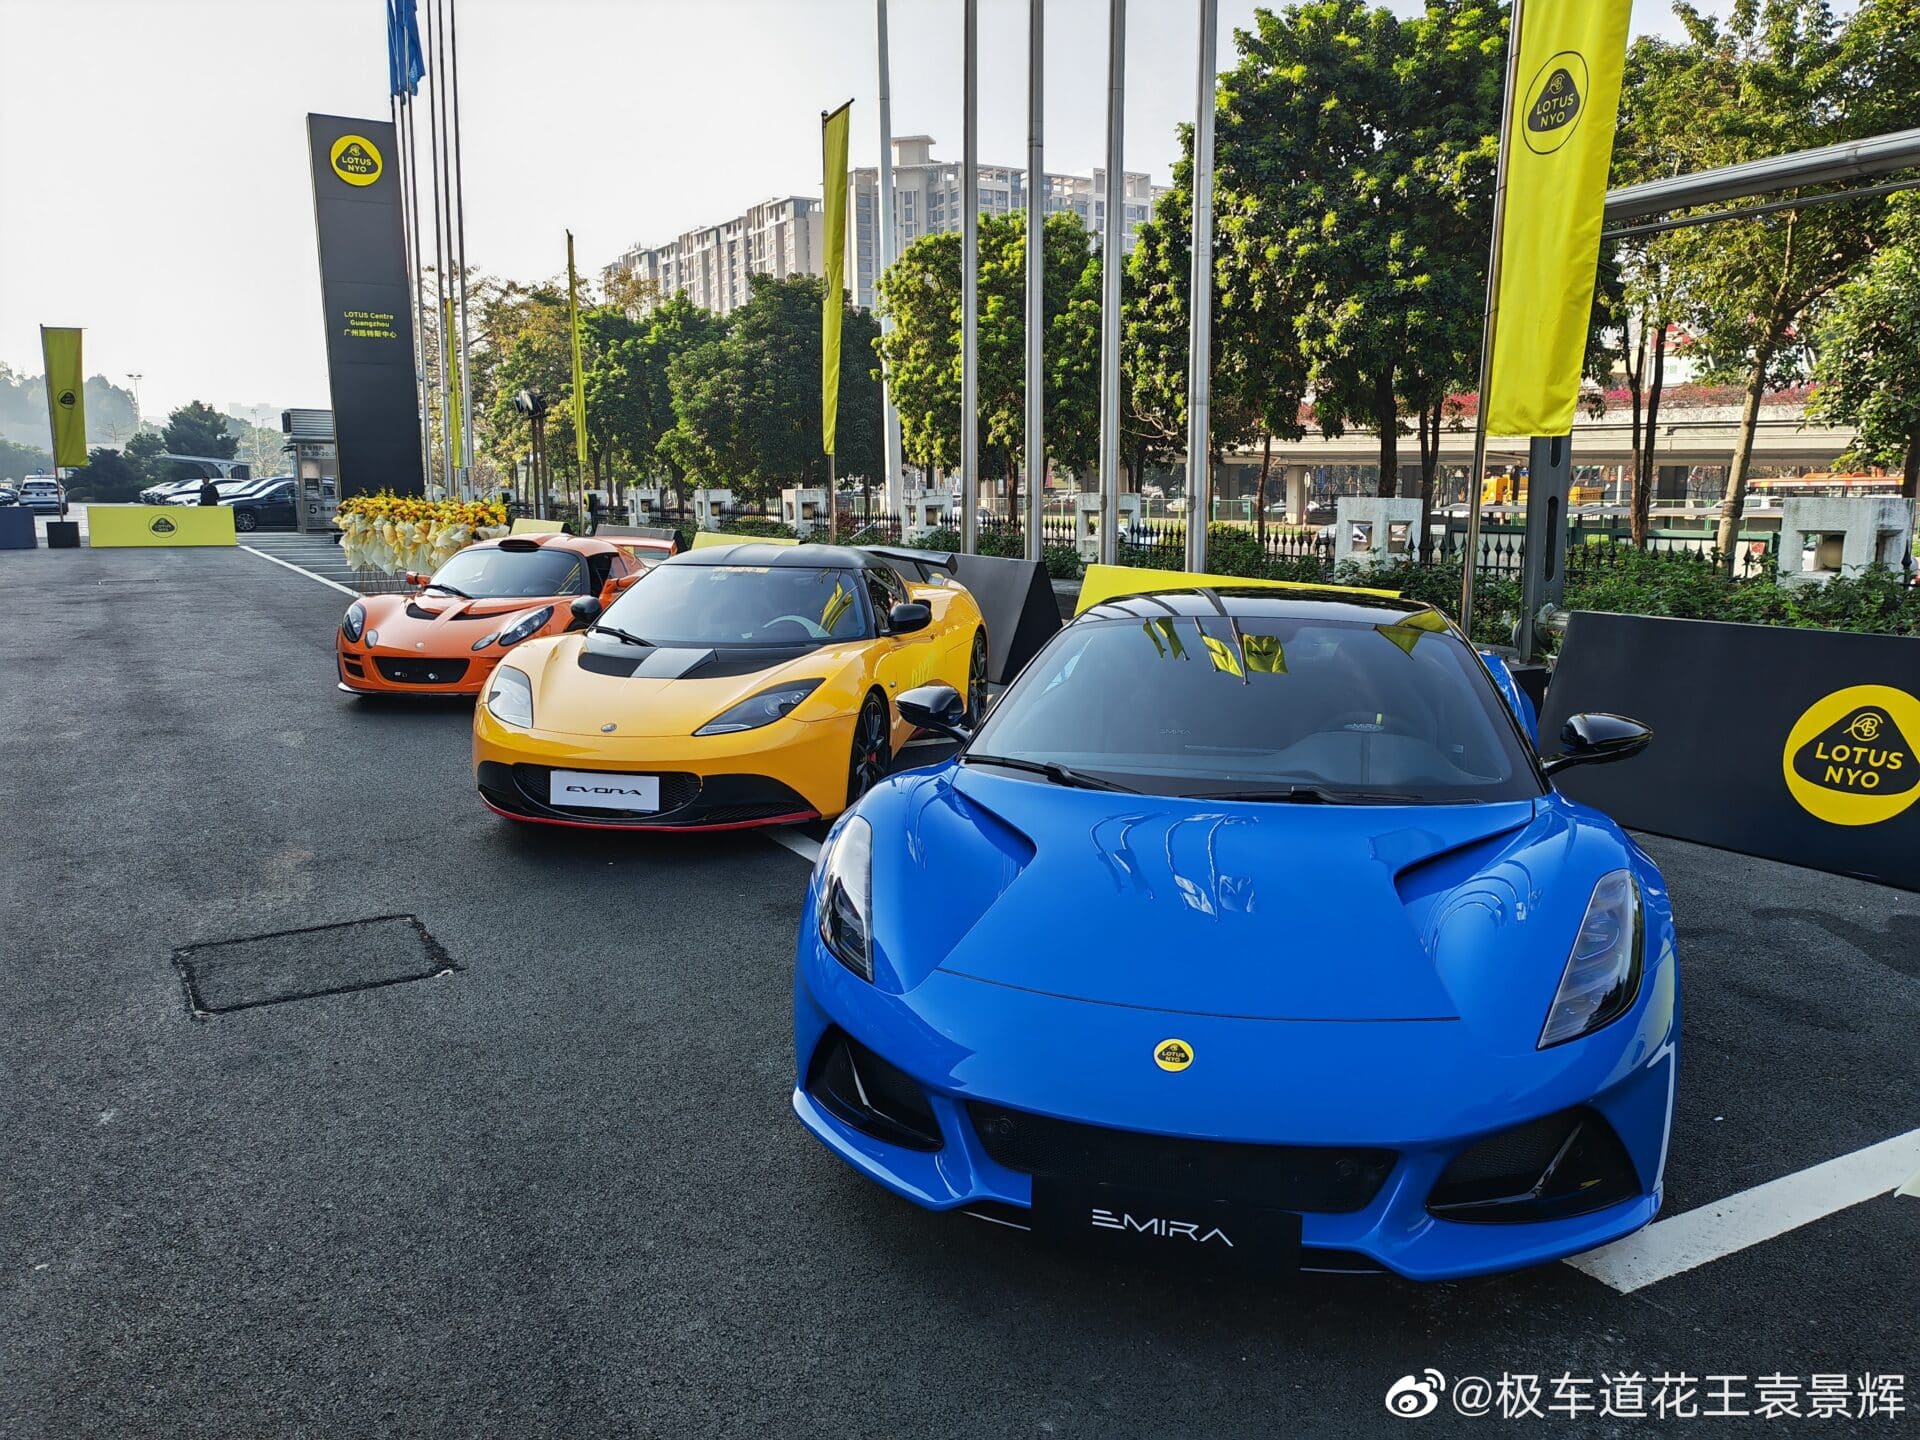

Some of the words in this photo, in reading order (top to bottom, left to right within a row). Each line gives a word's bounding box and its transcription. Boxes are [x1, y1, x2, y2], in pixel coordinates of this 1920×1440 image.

[1536, 93, 1575, 115] LOTUS
[1540, 111, 1565, 128] NYO
[341, 156, 372, 166] LOTUS
[347, 165, 367, 173] NYO
[343, 311, 369, 319] LOTUS
[370, 312, 394, 320] Centre
[350, 319, 390, 328] Guangzhou
[1815, 741, 1904, 770] LOTUS
[1824, 765, 1880, 789] NYO
[565, 785, 643, 796] EVORA
[1092, 1208, 1234, 1247] EMIRA
